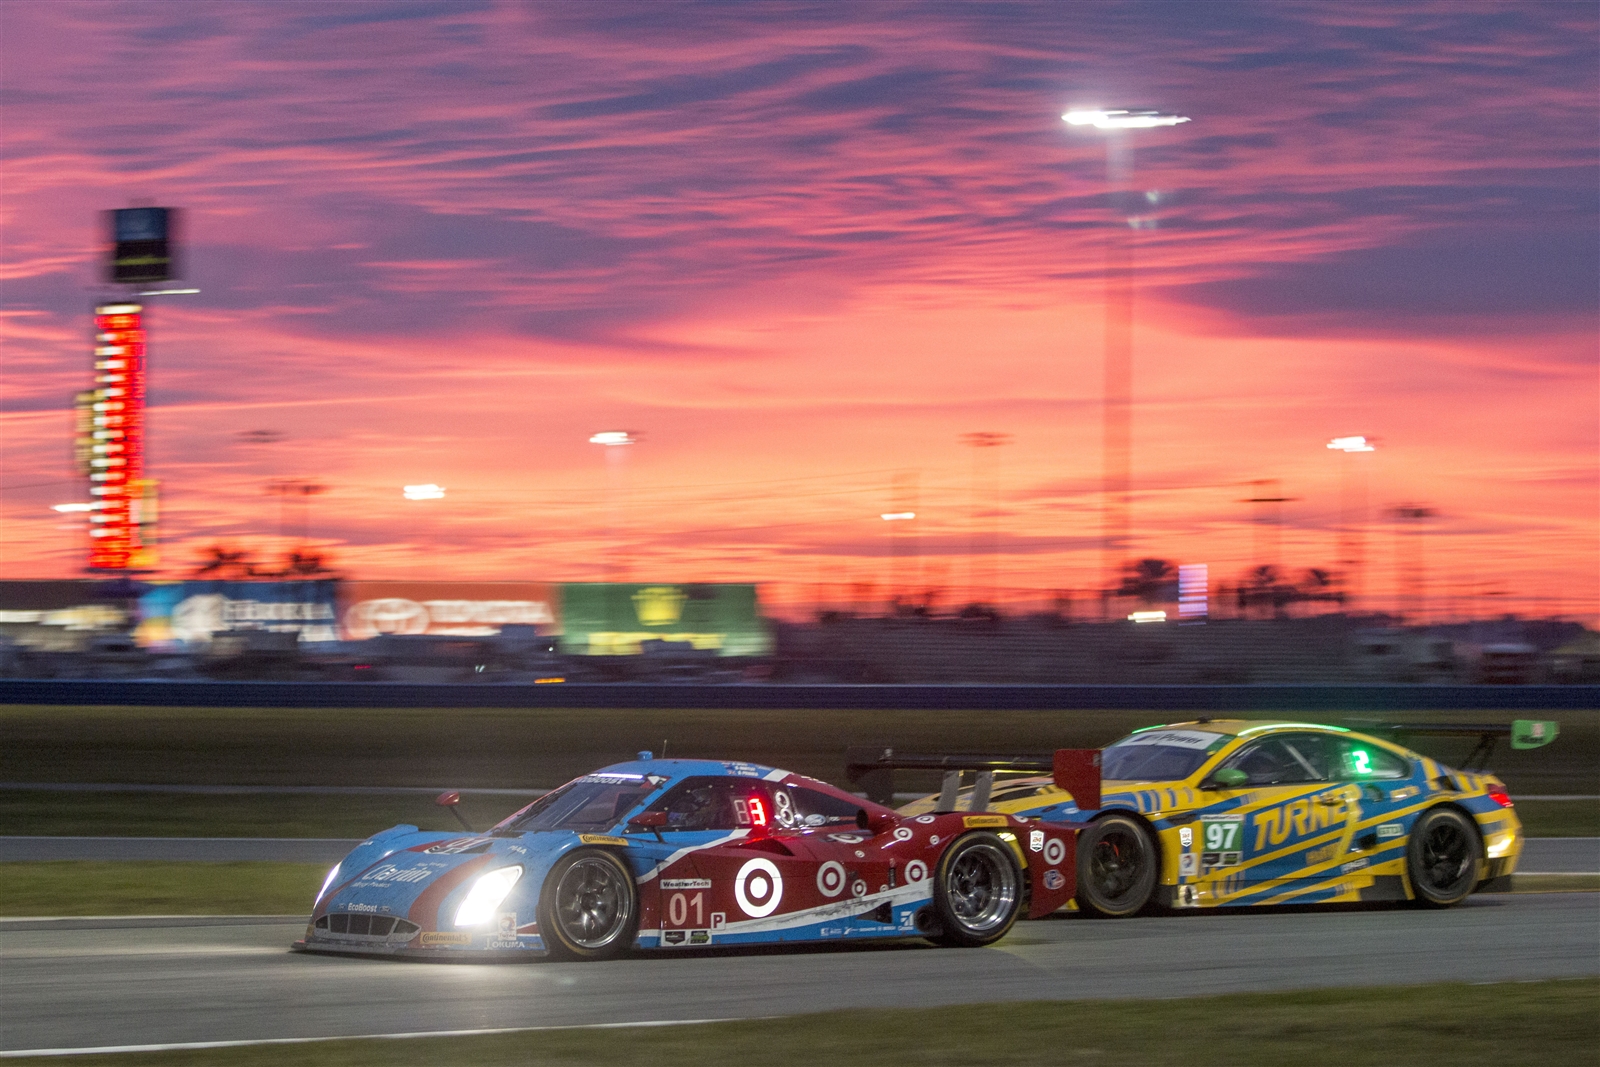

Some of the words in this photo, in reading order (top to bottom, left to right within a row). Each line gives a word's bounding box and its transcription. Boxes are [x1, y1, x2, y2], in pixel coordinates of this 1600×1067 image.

[1352, 750, 1372, 774] 2
[748, 798, 766, 825] 3
[1207, 823, 1240, 850] 97
[347, 903, 378, 912] EcoBoost
[669, 892, 703, 926] 01
[713, 914, 723, 929] P
[422, 933, 461, 943] Continental
[491, 941, 525, 949] OKUMA
